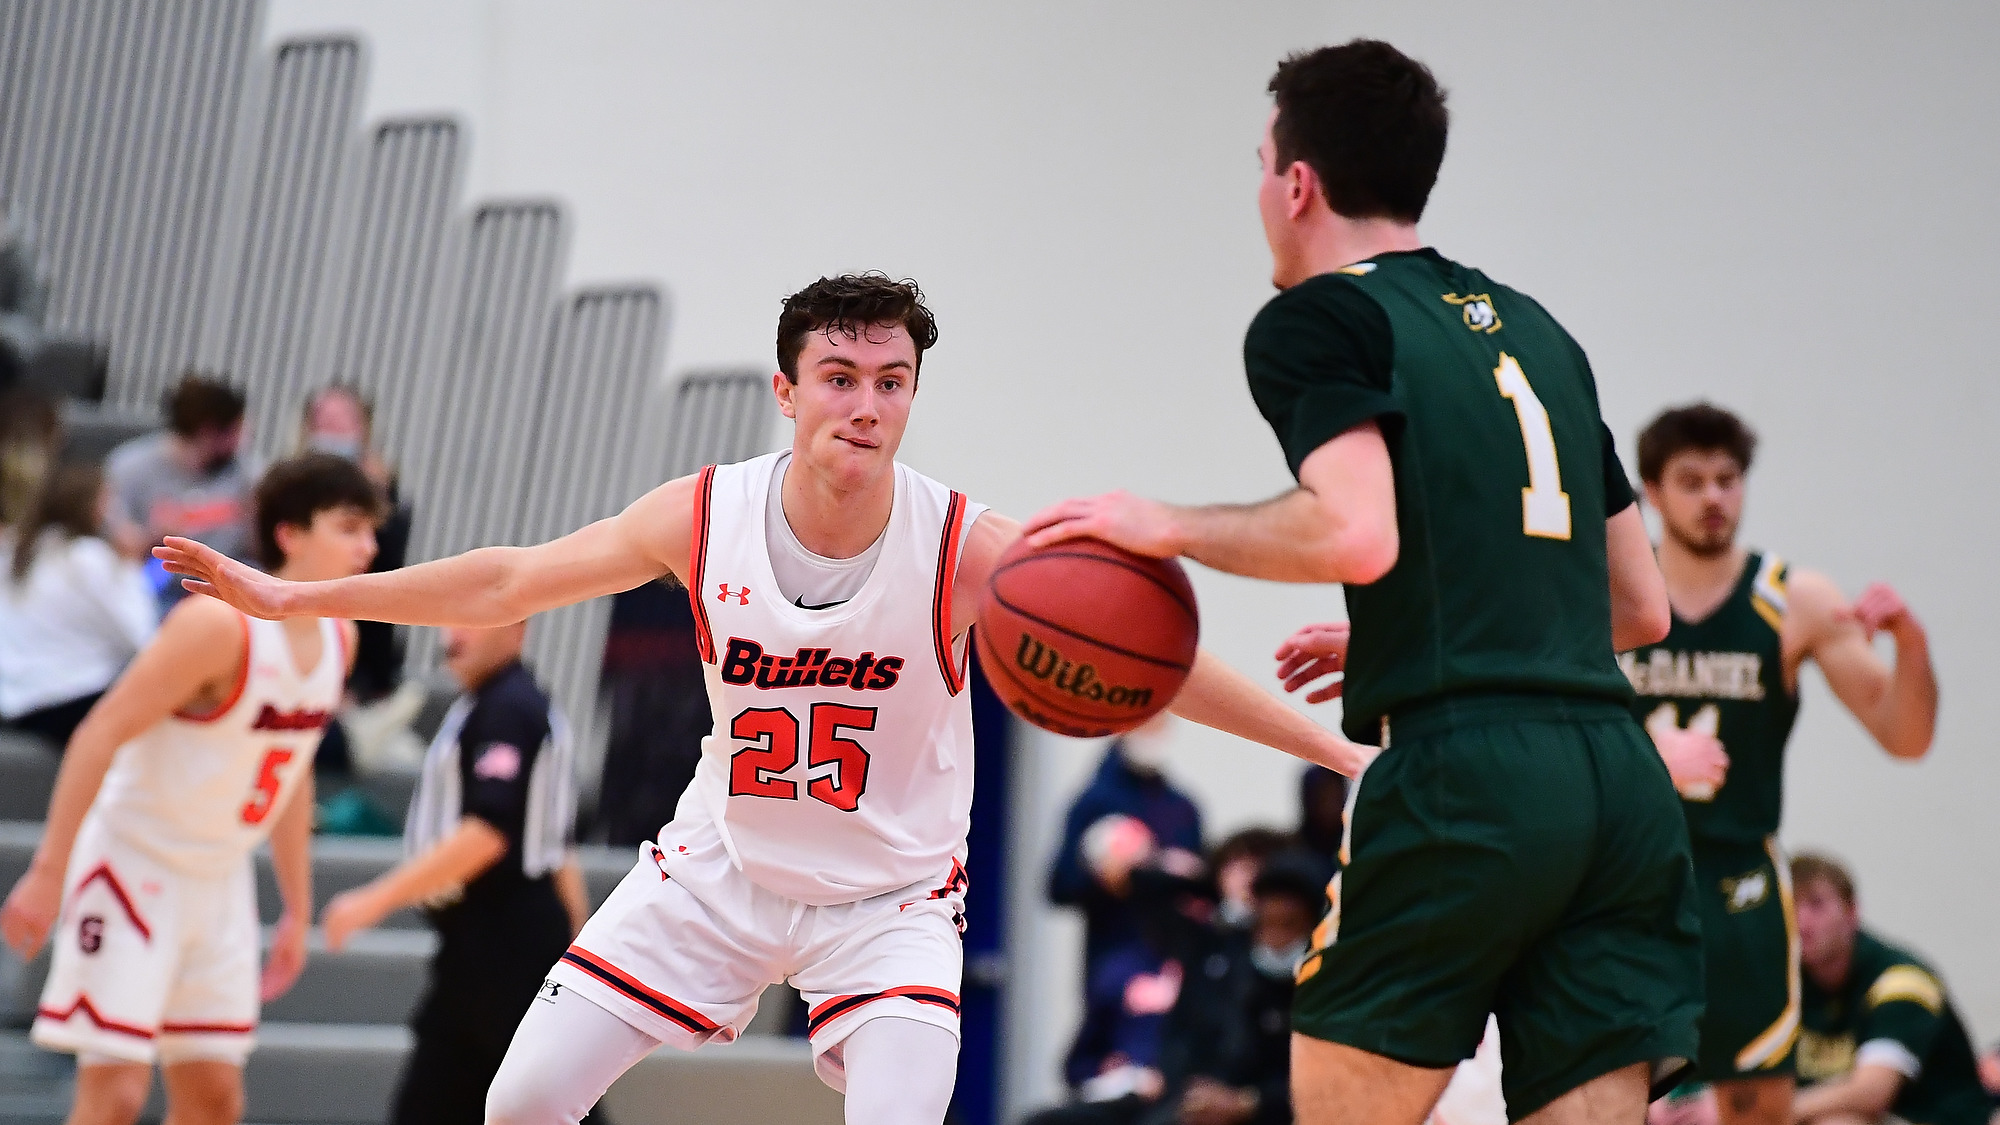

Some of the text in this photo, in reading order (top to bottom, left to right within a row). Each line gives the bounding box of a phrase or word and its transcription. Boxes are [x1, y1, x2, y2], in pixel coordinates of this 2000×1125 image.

[1493, 351, 1572, 540] 1
[721, 636, 905, 691] Bullets
[1016, 632, 1154, 708] Wilson
[241, 746, 294, 825] 5
[728, 702, 878, 812] 25
